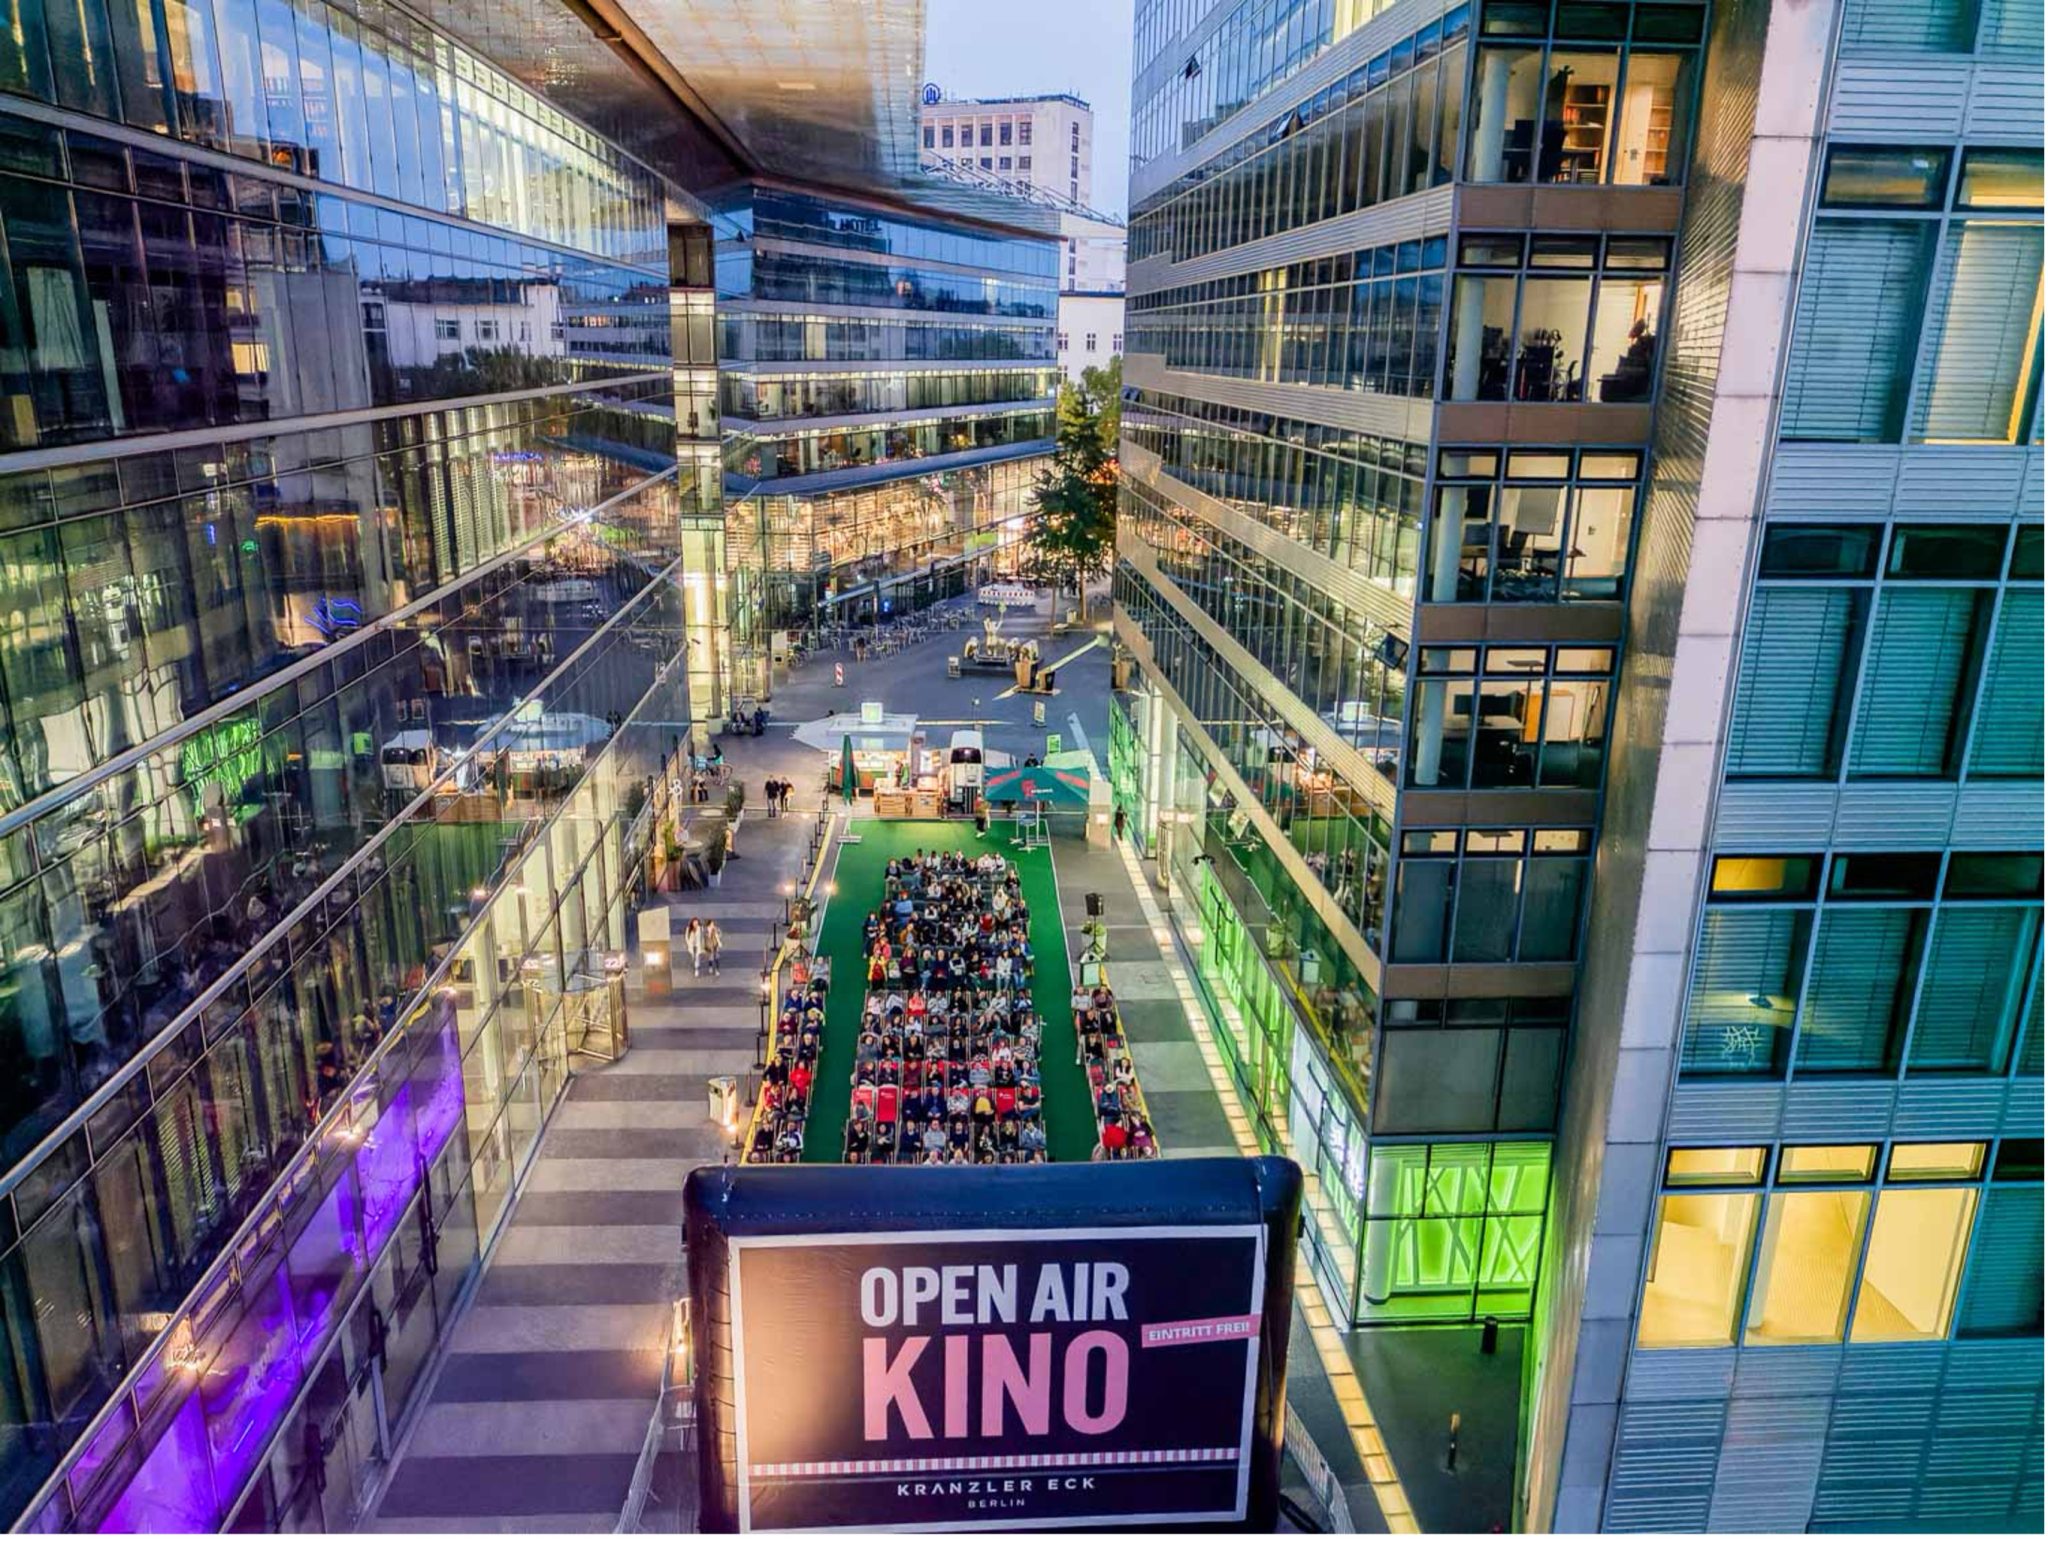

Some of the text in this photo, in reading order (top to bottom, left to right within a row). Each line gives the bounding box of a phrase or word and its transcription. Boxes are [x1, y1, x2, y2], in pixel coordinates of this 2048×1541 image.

[861, 1262, 1130, 1327] OPEN AIR
[1148, 1325, 1213, 1341] EINTRITT
[862, 1330, 1129, 1441] KINO
[897, 1477, 1095, 1496] KRANZLER ECK
[968, 1498, 1025, 1508] BERLIN
